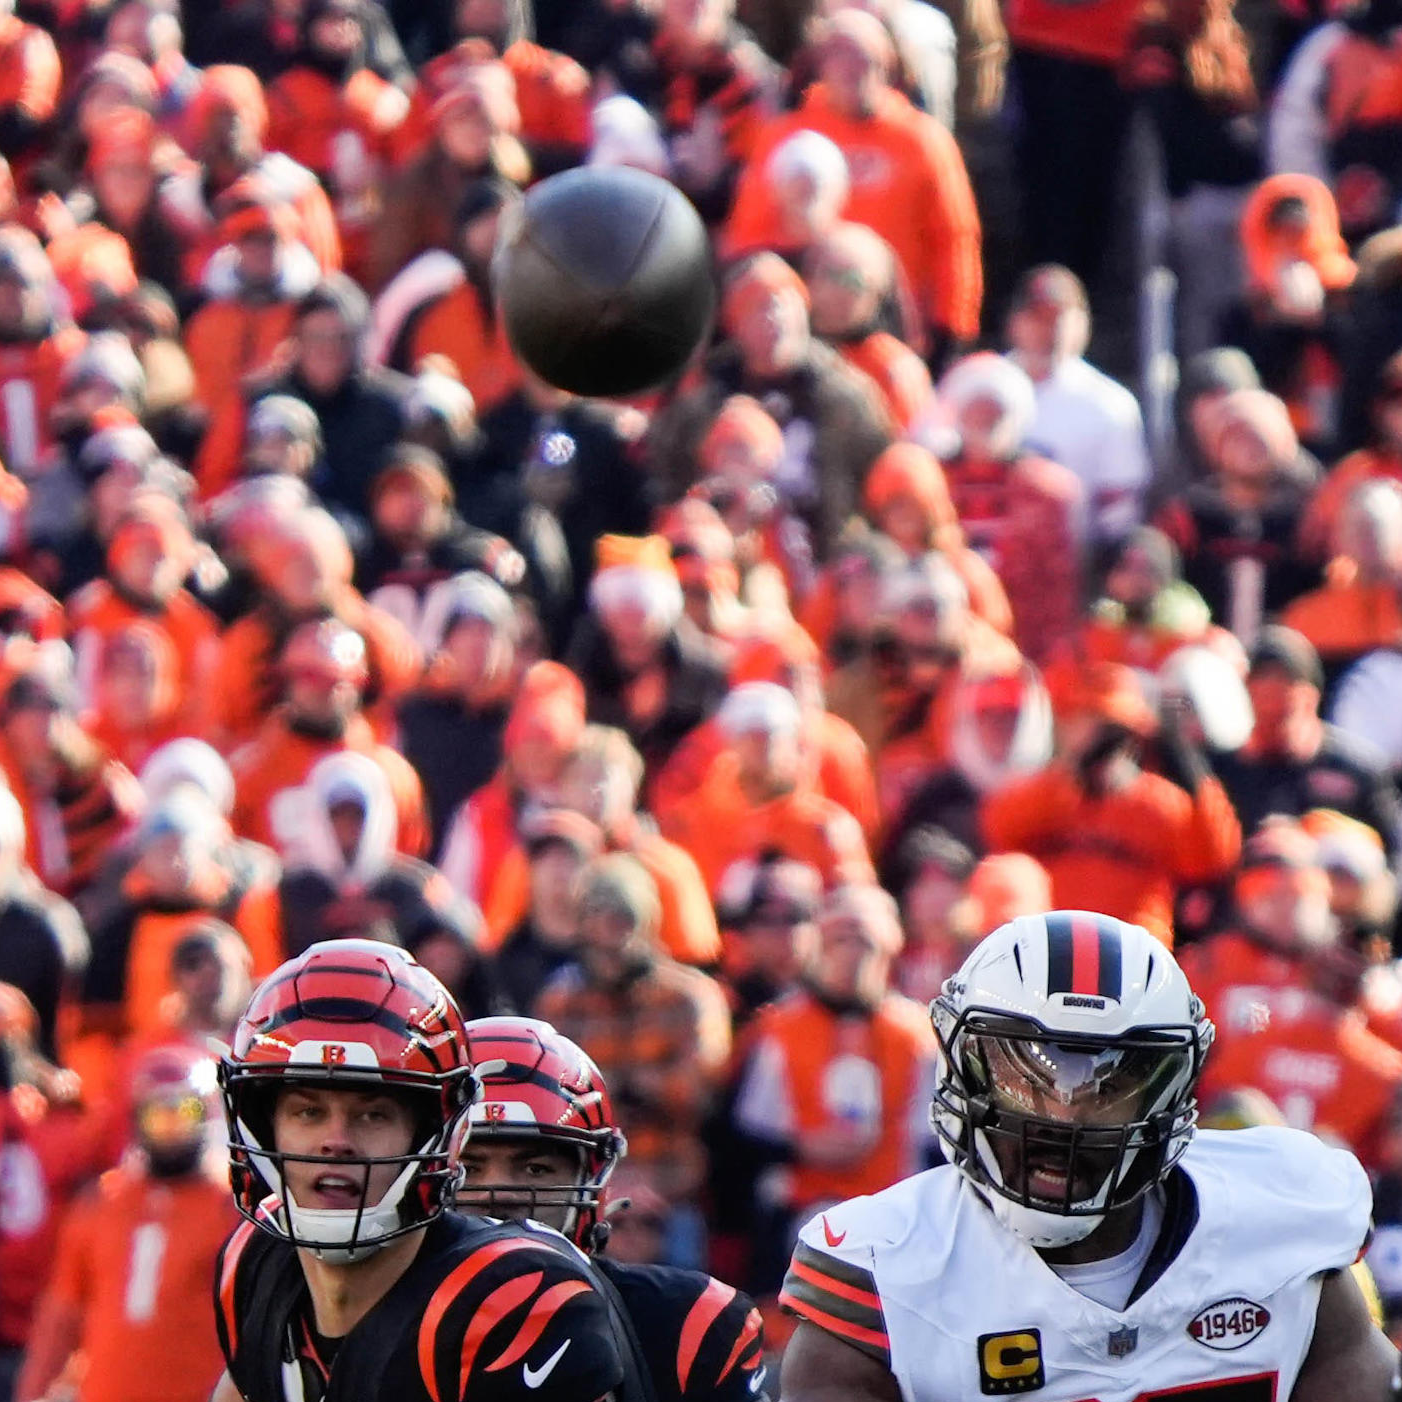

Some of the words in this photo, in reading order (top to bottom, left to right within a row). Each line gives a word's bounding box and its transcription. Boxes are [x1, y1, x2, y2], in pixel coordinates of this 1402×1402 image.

[124, 1221, 167, 1324] 1
[1203, 1307, 1256, 1341] 1946
[983, 1331, 1039, 1381] C
